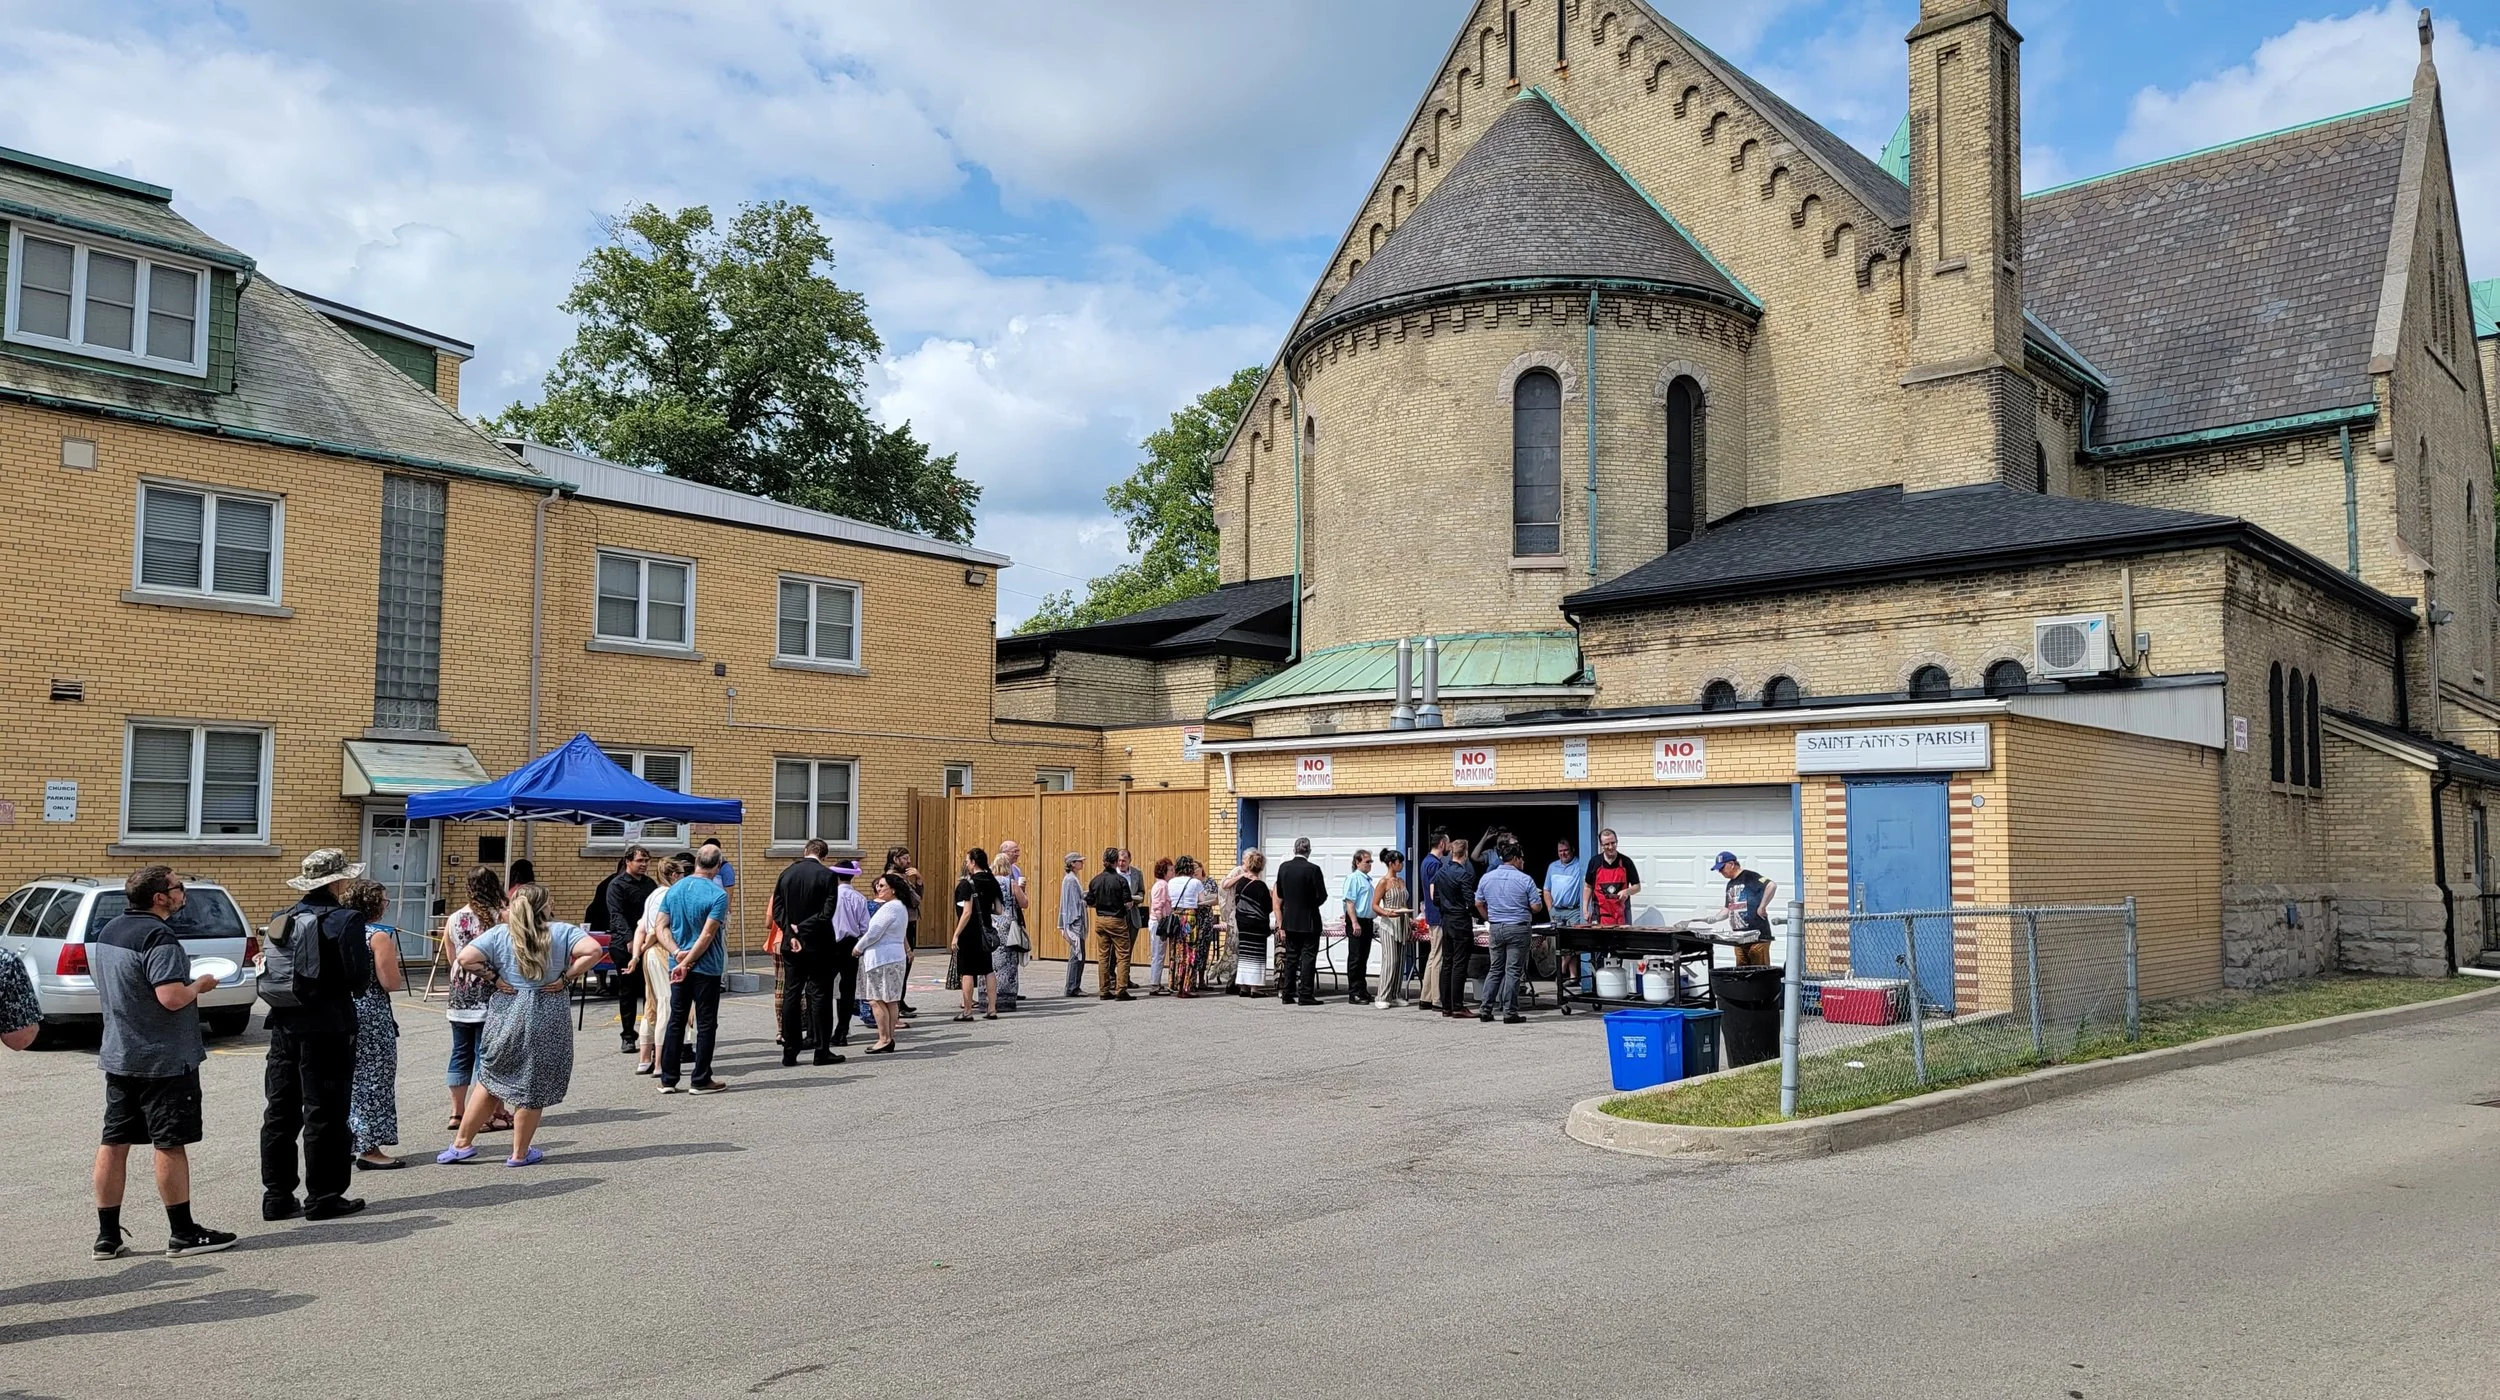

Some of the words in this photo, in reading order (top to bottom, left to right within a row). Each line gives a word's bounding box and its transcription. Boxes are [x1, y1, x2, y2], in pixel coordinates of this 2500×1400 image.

[1807, 736, 1854, 750] SAINT
[1859, 734, 1910, 748] ANN'S
[1916, 731, 1976, 746] PARISH
[1664, 742, 1694, 757] NO
[1303, 759, 1325, 771] NO
[1461, 752, 1487, 766] NO
[1455, 767, 1494, 781] PARKING
[1656, 760, 1703, 774] PARKING
[1297, 773, 1331, 786] PARKING
